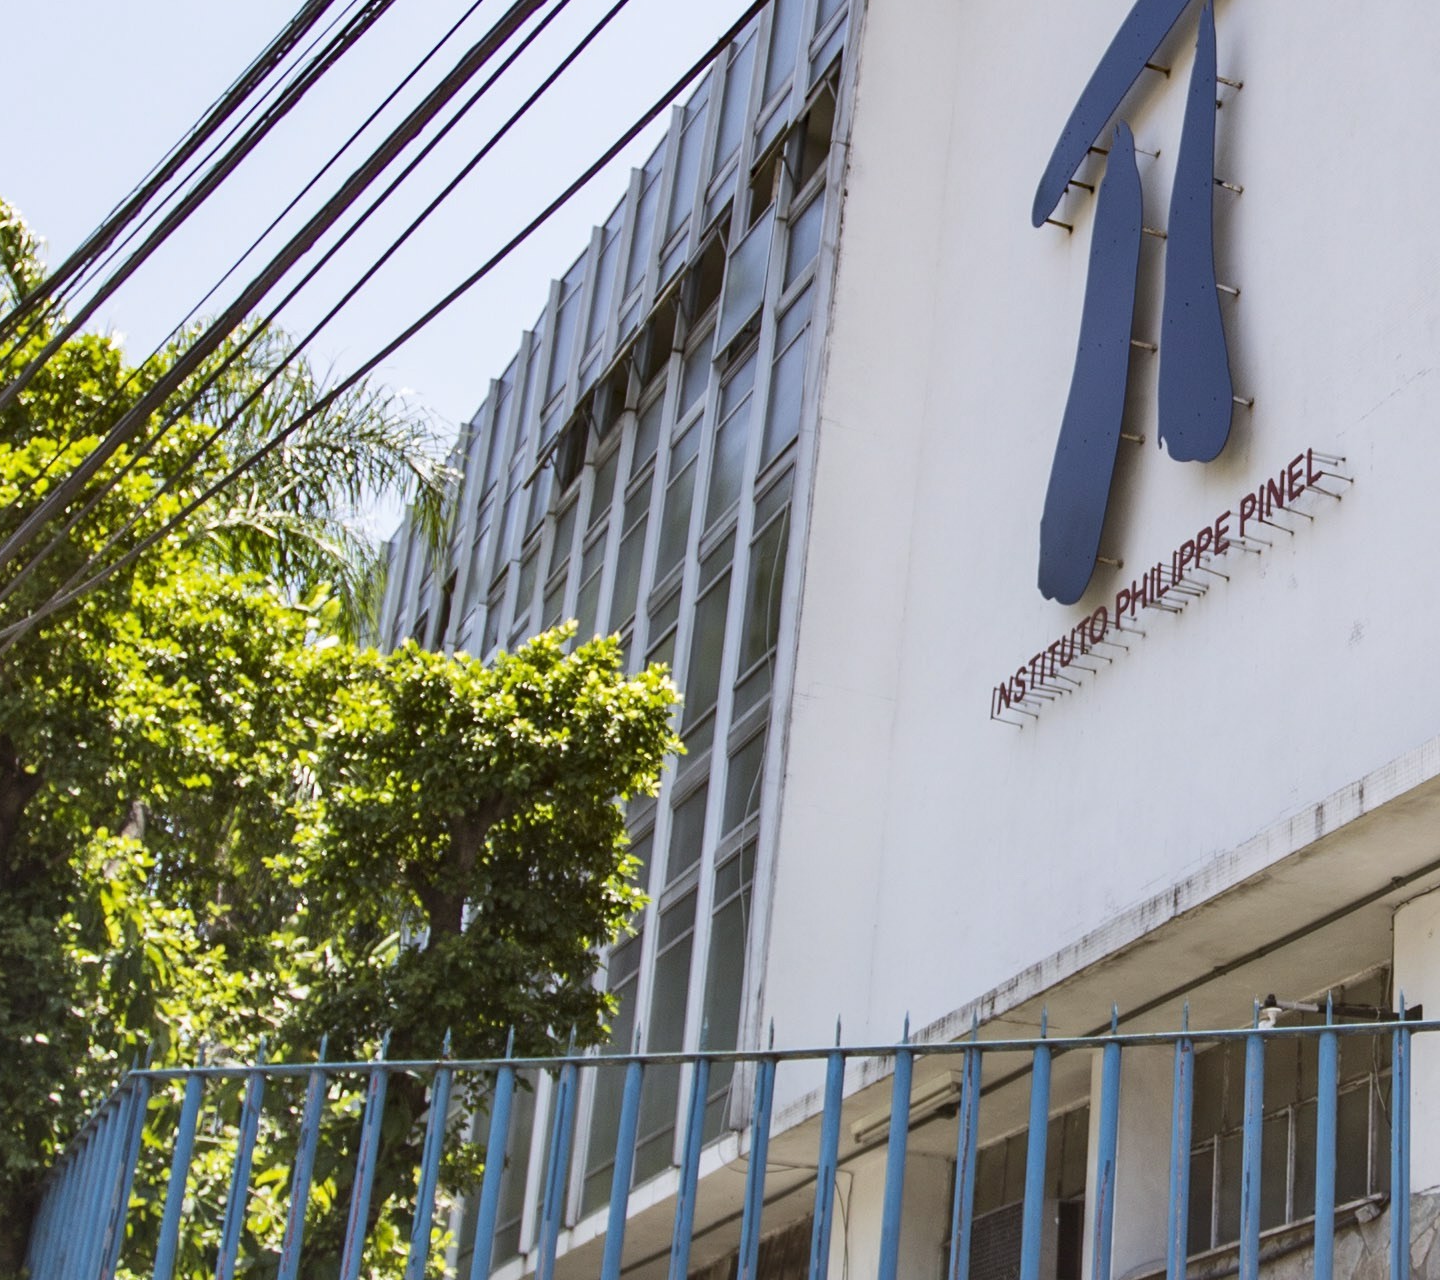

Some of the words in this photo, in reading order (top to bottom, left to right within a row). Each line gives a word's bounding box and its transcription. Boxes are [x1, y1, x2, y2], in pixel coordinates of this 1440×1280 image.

[991, 606, 1108, 720] INSTITUTO
[1116, 510, 1230, 630] PHILIPPE
[1240, 448, 1323, 537] PINEL
